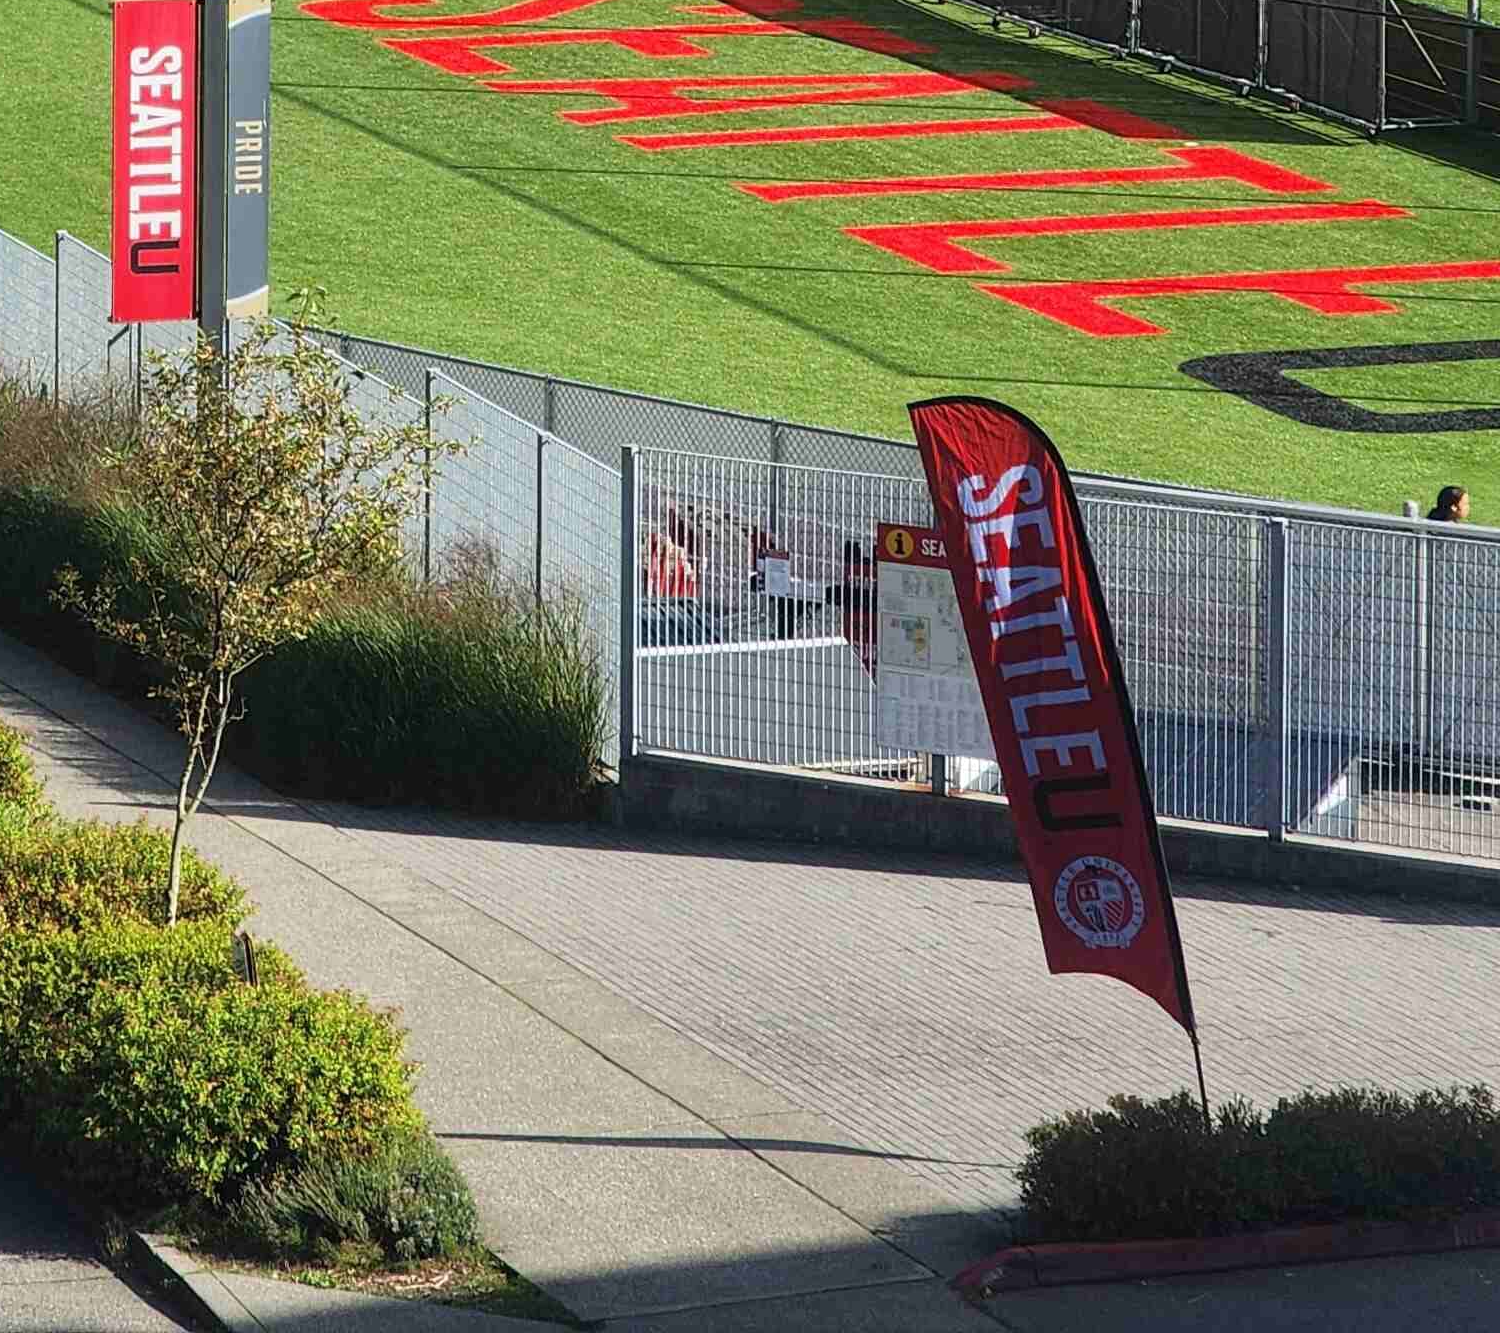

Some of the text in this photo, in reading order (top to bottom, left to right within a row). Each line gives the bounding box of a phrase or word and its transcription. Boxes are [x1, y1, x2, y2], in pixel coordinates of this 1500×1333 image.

[128, 45, 183, 275] SEATTLEU
[234, 119, 264, 196] PRIDE
[957, 463, 1123, 831] SEATTLEU
